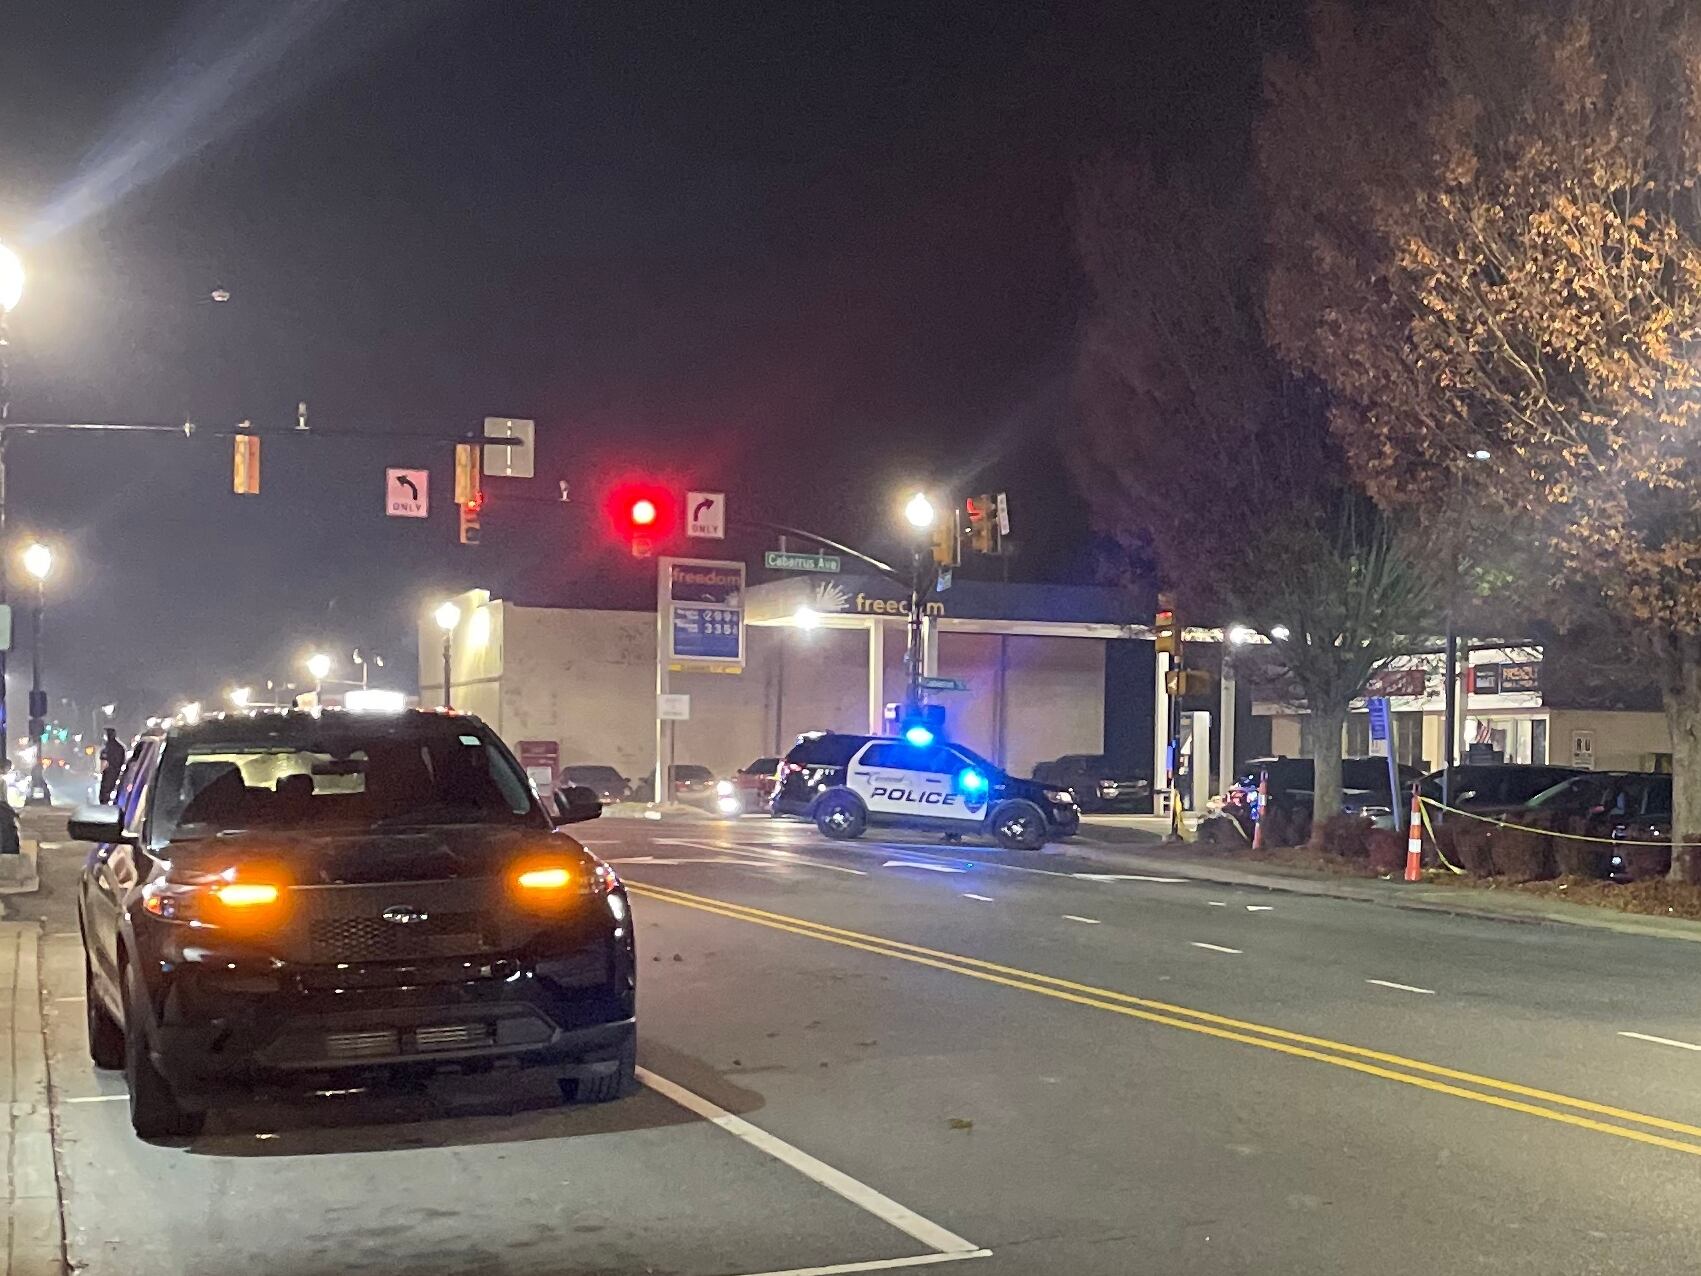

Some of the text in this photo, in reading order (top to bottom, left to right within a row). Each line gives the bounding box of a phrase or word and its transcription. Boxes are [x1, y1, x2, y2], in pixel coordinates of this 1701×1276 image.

[393, 502, 421, 511] ONLY
[692, 523, 718, 533] ONLY
[768, 554, 837, 570] Cabarrus Ave
[672, 567, 740, 586] freedom
[856, 592, 945, 616] freem
[871, 787, 957, 806] POLICE
